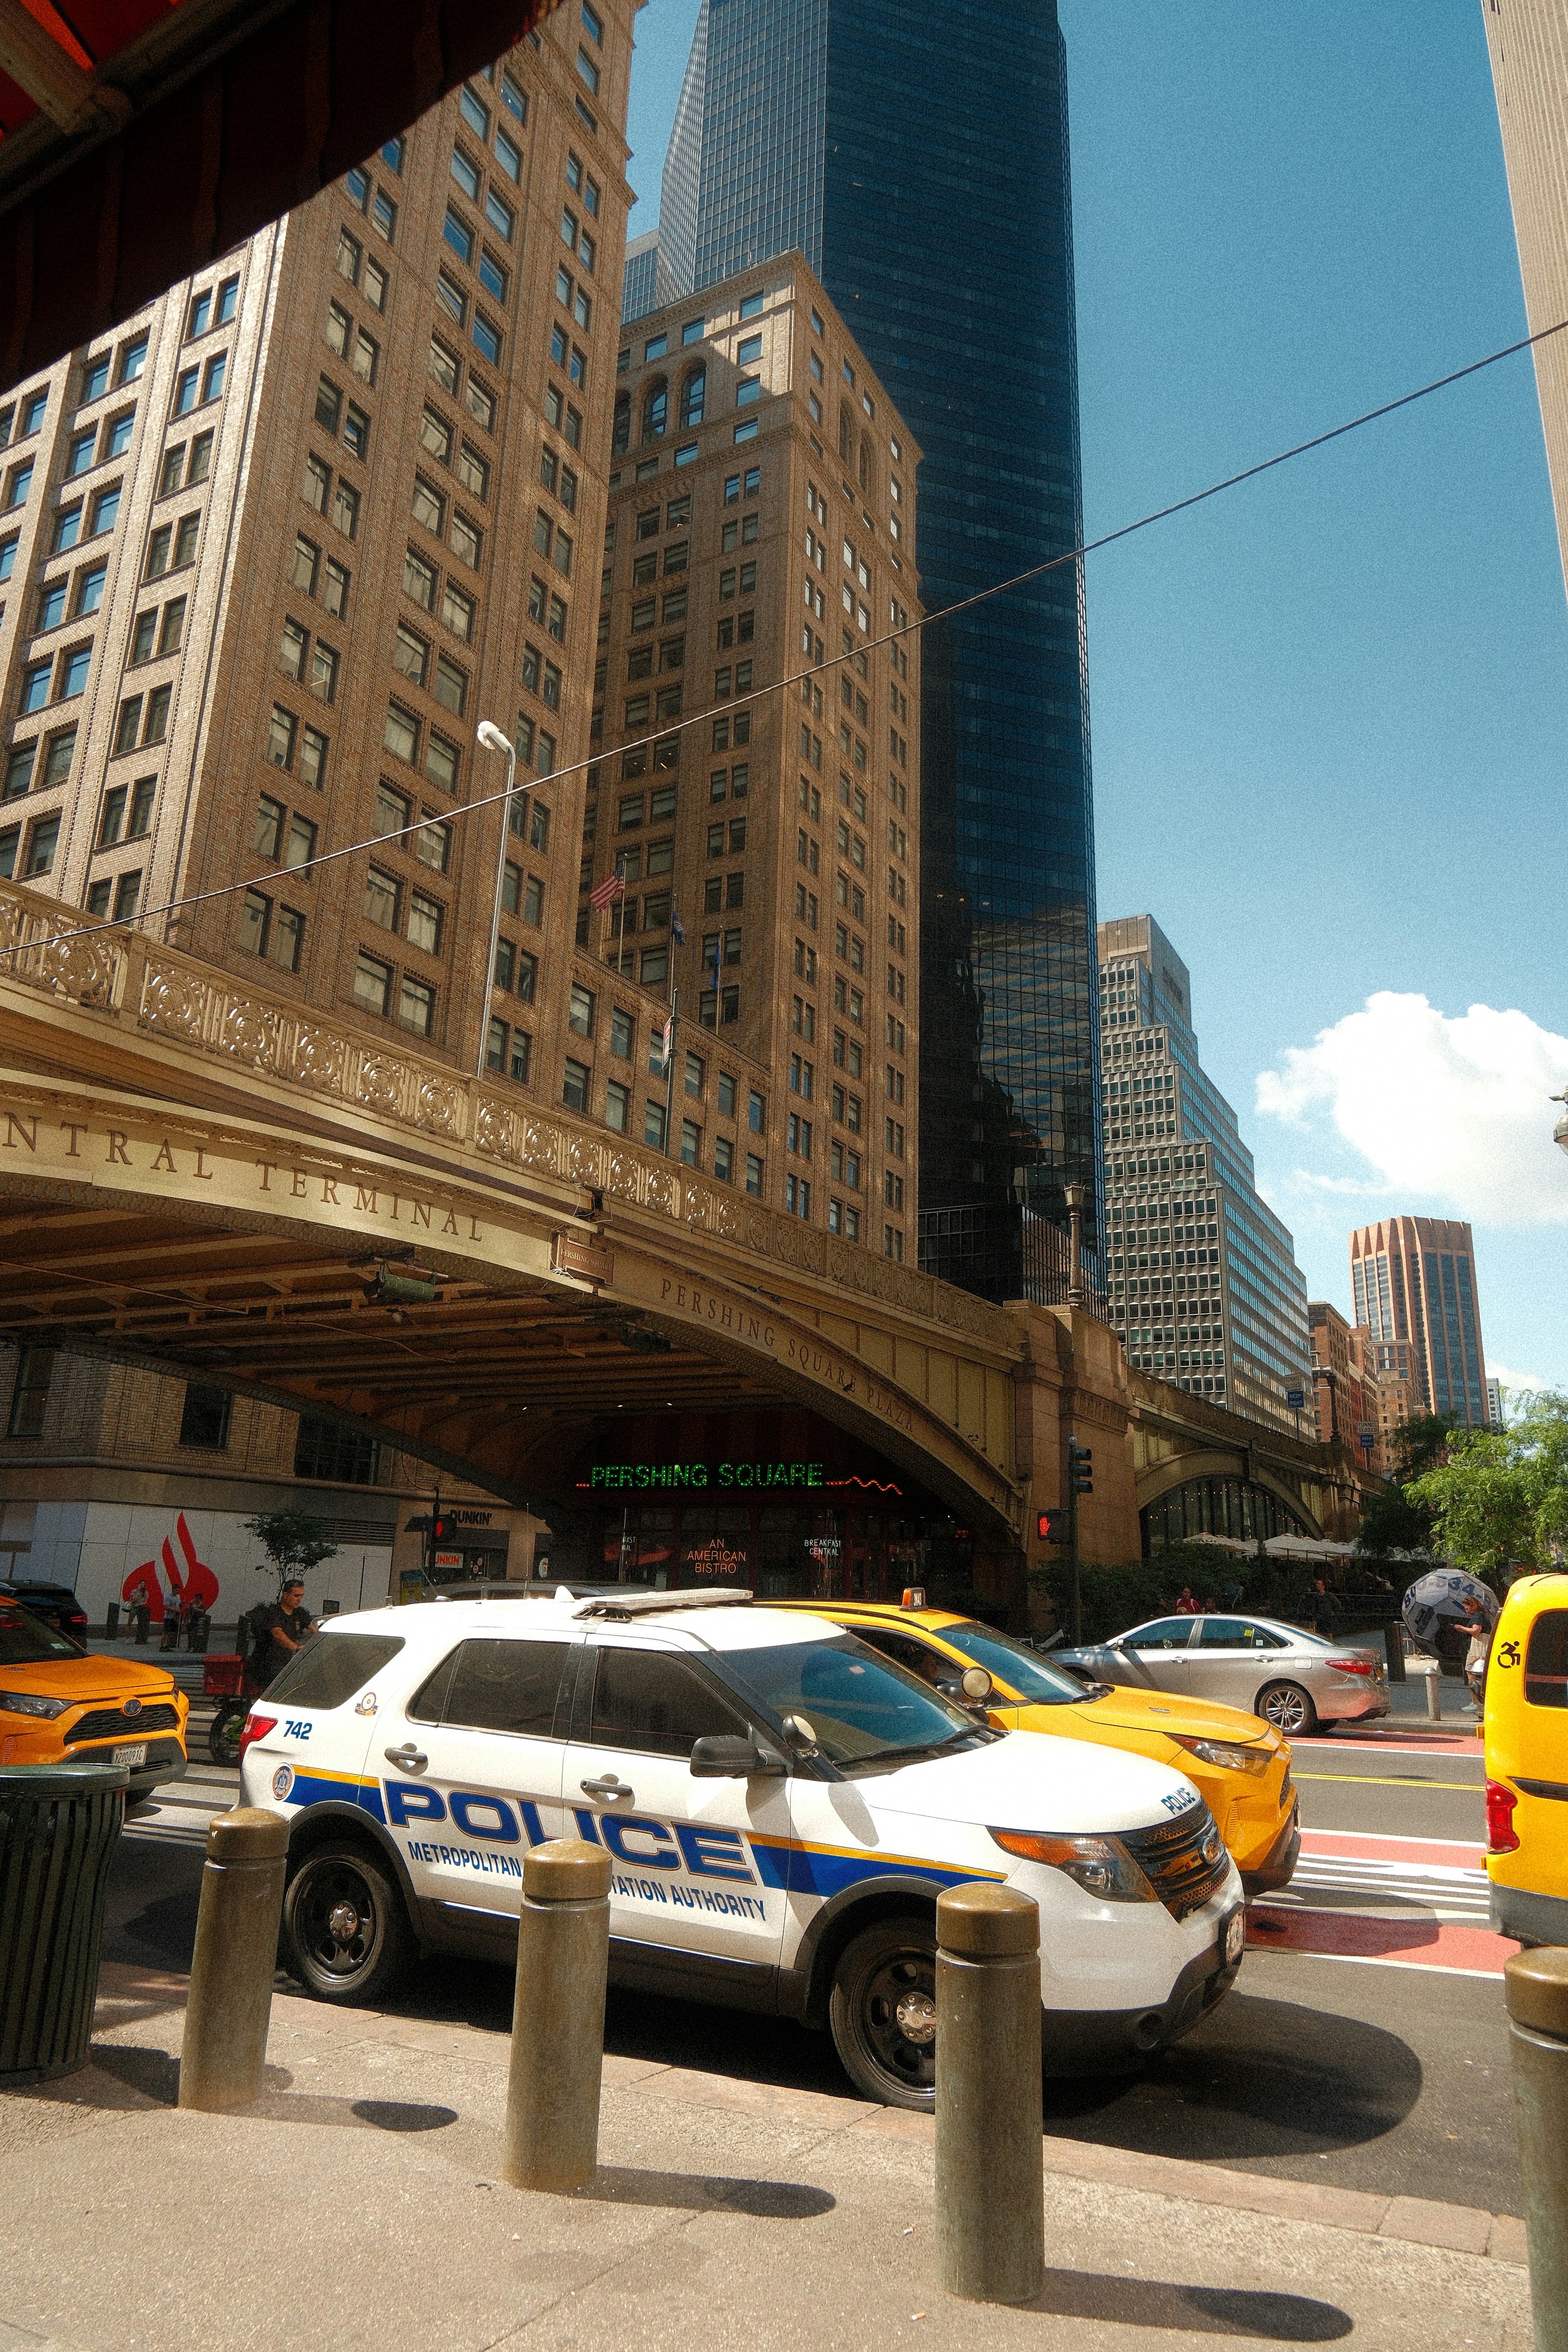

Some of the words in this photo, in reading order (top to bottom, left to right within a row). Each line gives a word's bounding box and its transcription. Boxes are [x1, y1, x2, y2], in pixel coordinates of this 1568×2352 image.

[256, 1159, 483, 1242] TERMINAL
[590, 1258, 611, 1271] SQUARE
[660, 1278, 775, 1347] PERSHING
[788, 1338, 857, 1393] SQUARE
[867, 1383, 914, 1433] PLAZA
[591, 1464, 708, 1488] PERSHING
[718, 1463, 824, 1487] SQUARE
[450, 1509, 492, 1525] DUNKIN'
[709, 1538, 724, 1549] AN
[804, 1539, 841, 1547] BREAKFAST
[687, 1550, 746, 1562] AMERICAN
[695, 1563, 737, 1574] BISTRO
[283, 1720, 313, 1741] 742
[115, 1749, 143, 1764] Y200091C
[1161, 1787, 1196, 1815] POLICE
[383, 1778, 757, 1886] POLICE
[407, 1841, 522, 1877] METROPOLITAN
[671, 1884, 767, 1922] AUTHORITY
